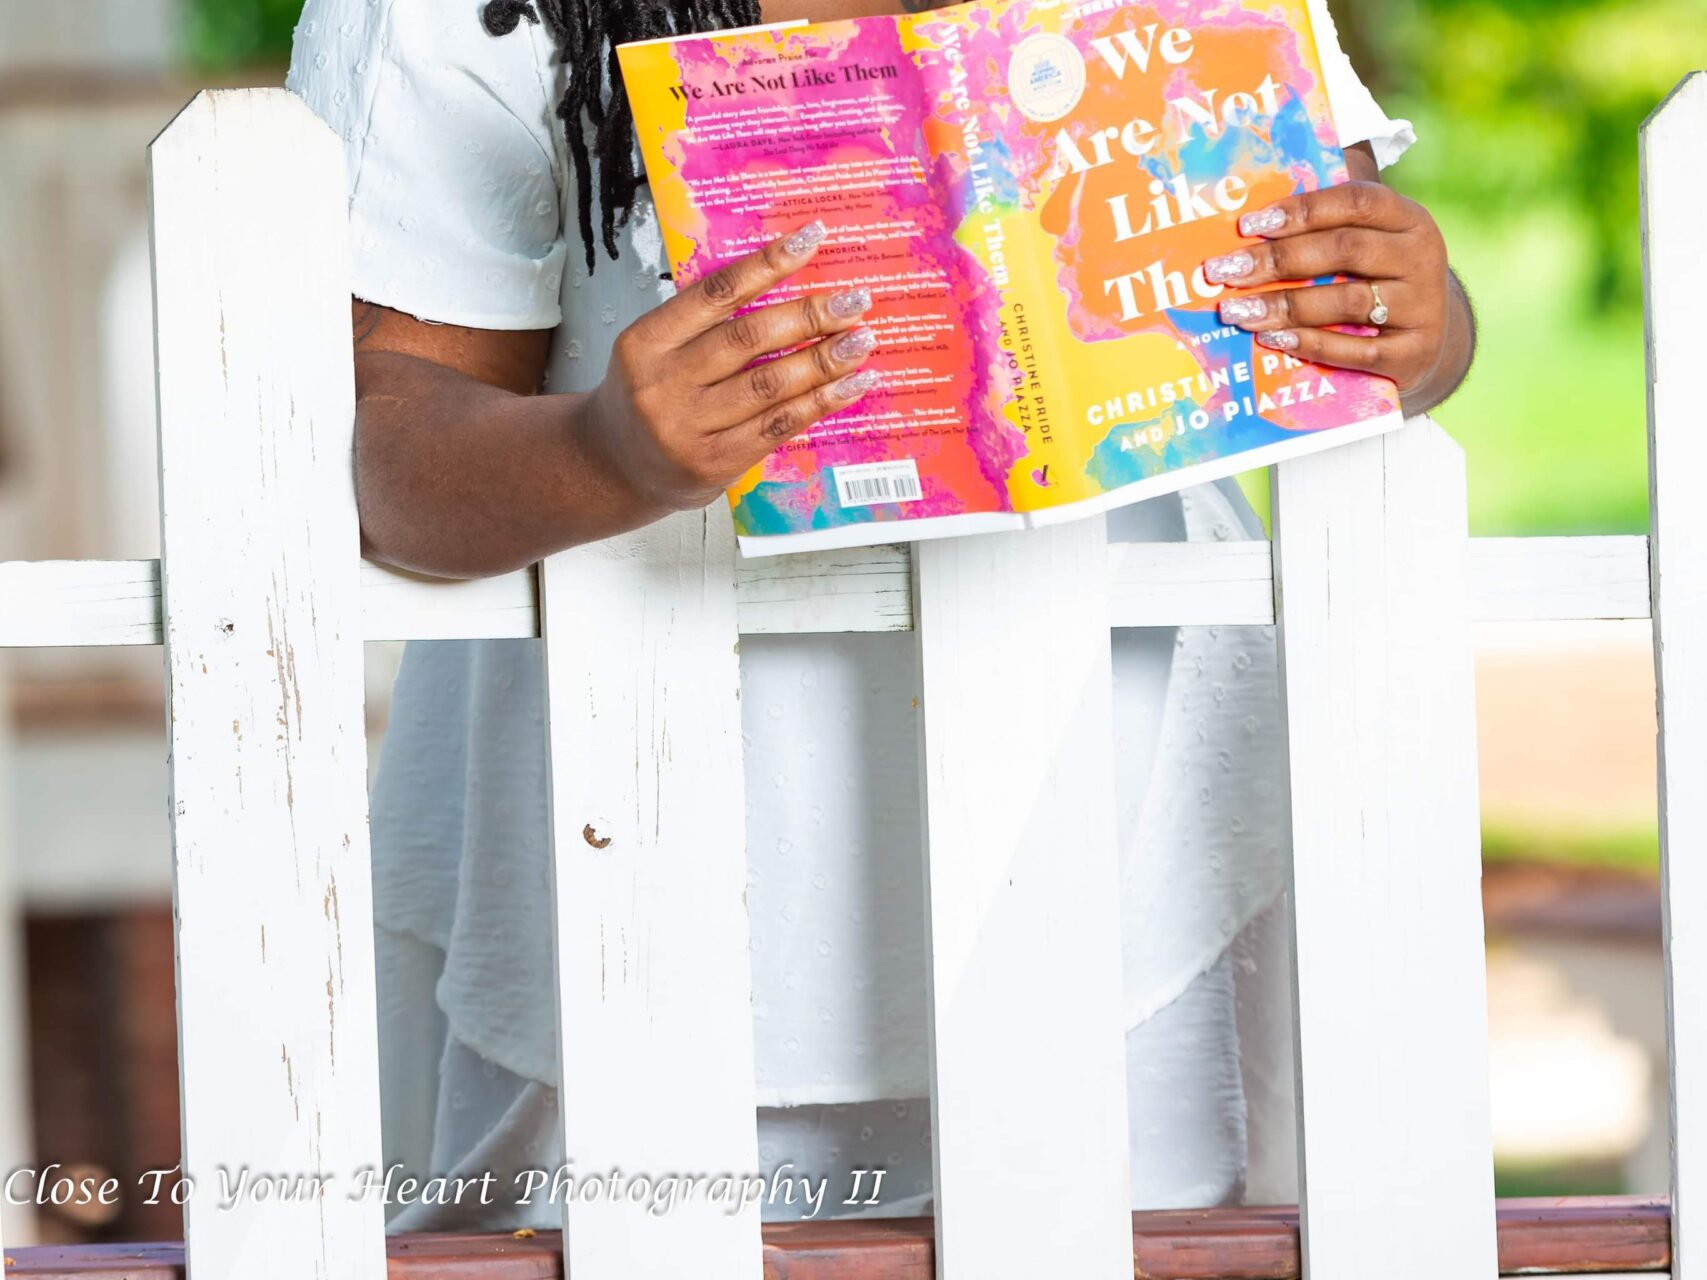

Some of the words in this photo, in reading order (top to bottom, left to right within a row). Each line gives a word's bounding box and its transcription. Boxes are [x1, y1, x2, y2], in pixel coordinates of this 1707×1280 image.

[940, 23, 961, 62] We
[1091, 23, 1194, 80] We
[668, 84, 704, 101] We
[710, 81, 746, 98] Are
[750, 75, 787, 93] Not
[791, 68, 837, 88] Like
[839, 64, 898, 82] Them
[948, 67, 970, 111] Are
[960, 115, 981, 160] Not
[1049, 118, 1156, 181] Are
[1168, 74, 1281, 145] Not
[970, 163, 994, 214] Like
[1106, 173, 1248, 242] Like
[982, 218, 1008, 286] Them
[1103, 260, 1225, 323] The
[1000, 321, 1012, 346] AND
[1006, 352, 1019, 370] JO
[1193, 326, 1239, 348] NOVEL
[1014, 303, 1042, 390] CHRISTINE
[1034, 396, 1054, 444] PRIDE
[1087, 361, 1250, 426] CHRISTINE
[1012, 376, 1032, 433] PIAZZA
[1120, 425, 1164, 452] AND
[1176, 410, 1209, 436] JO
[1223, 377, 1338, 422] PIAZZA
